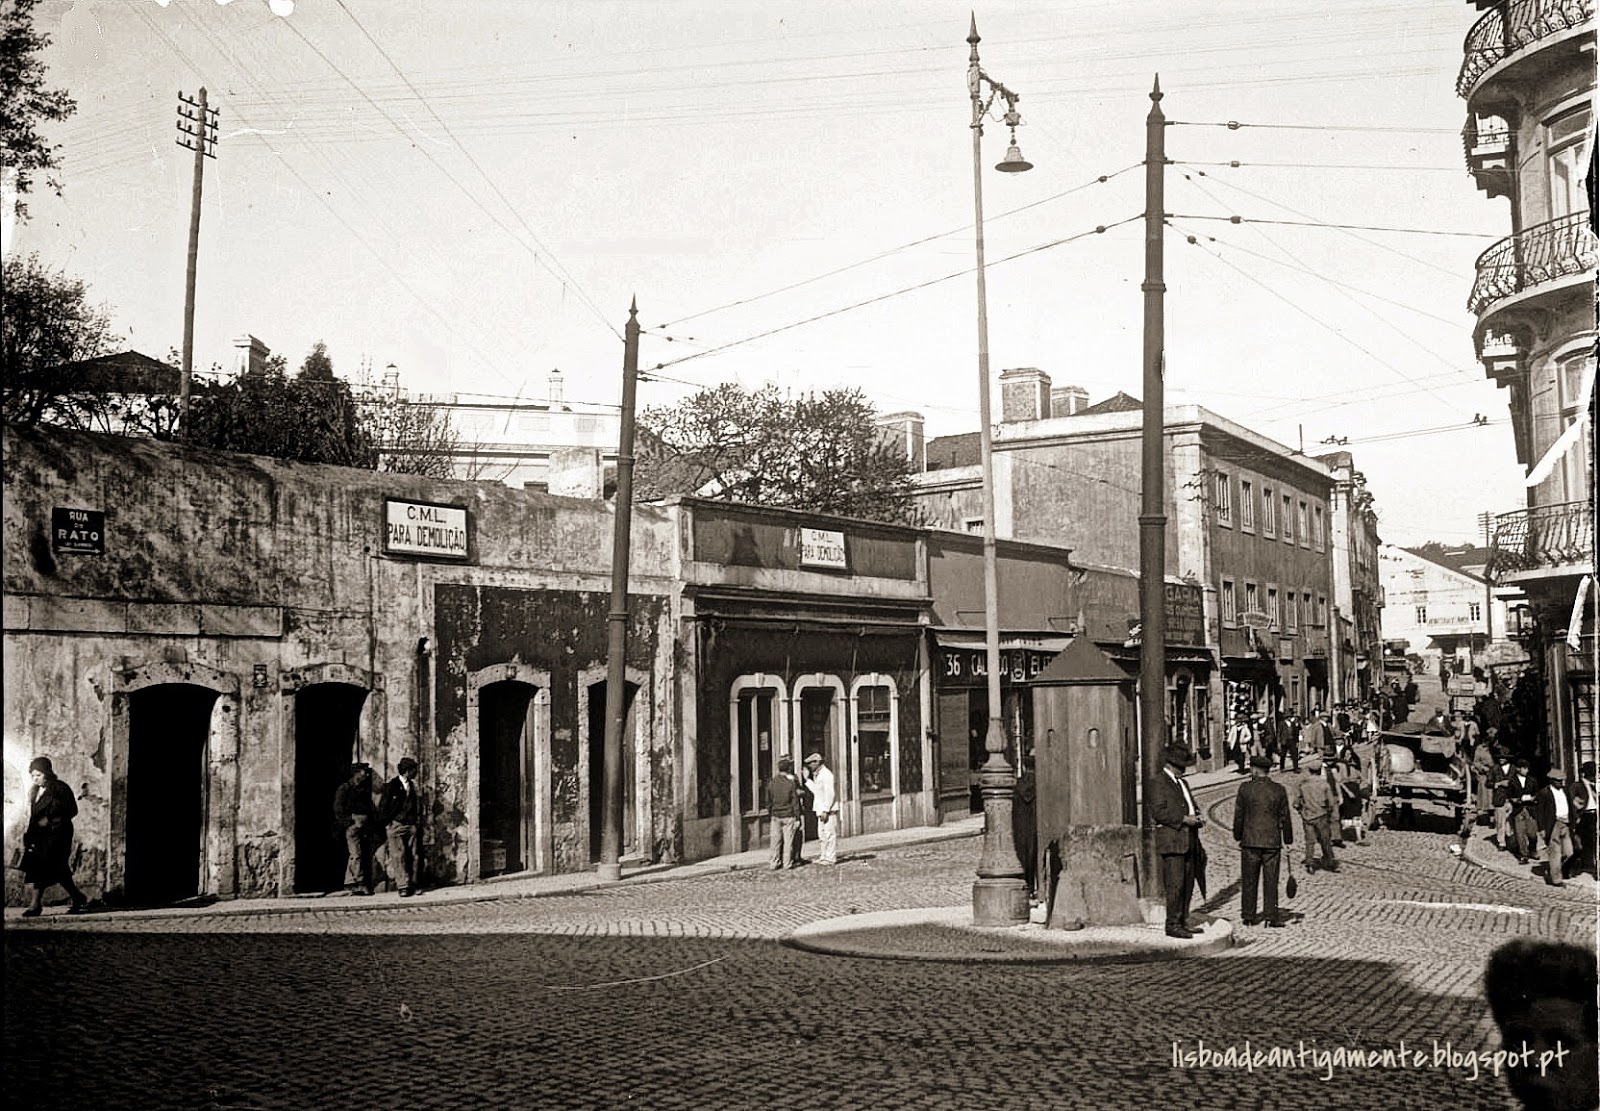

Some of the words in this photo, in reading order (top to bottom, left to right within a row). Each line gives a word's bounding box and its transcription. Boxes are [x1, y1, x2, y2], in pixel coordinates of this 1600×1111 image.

[69, 511, 89, 522] RUA
[407, 505, 447, 523] C.M.L.
[58, 528, 99, 542] RATO
[387, 523, 412, 546] PARA
[417, 525, 466, 554] DEMOLIÇÃO
[945, 653, 961, 676] 36
